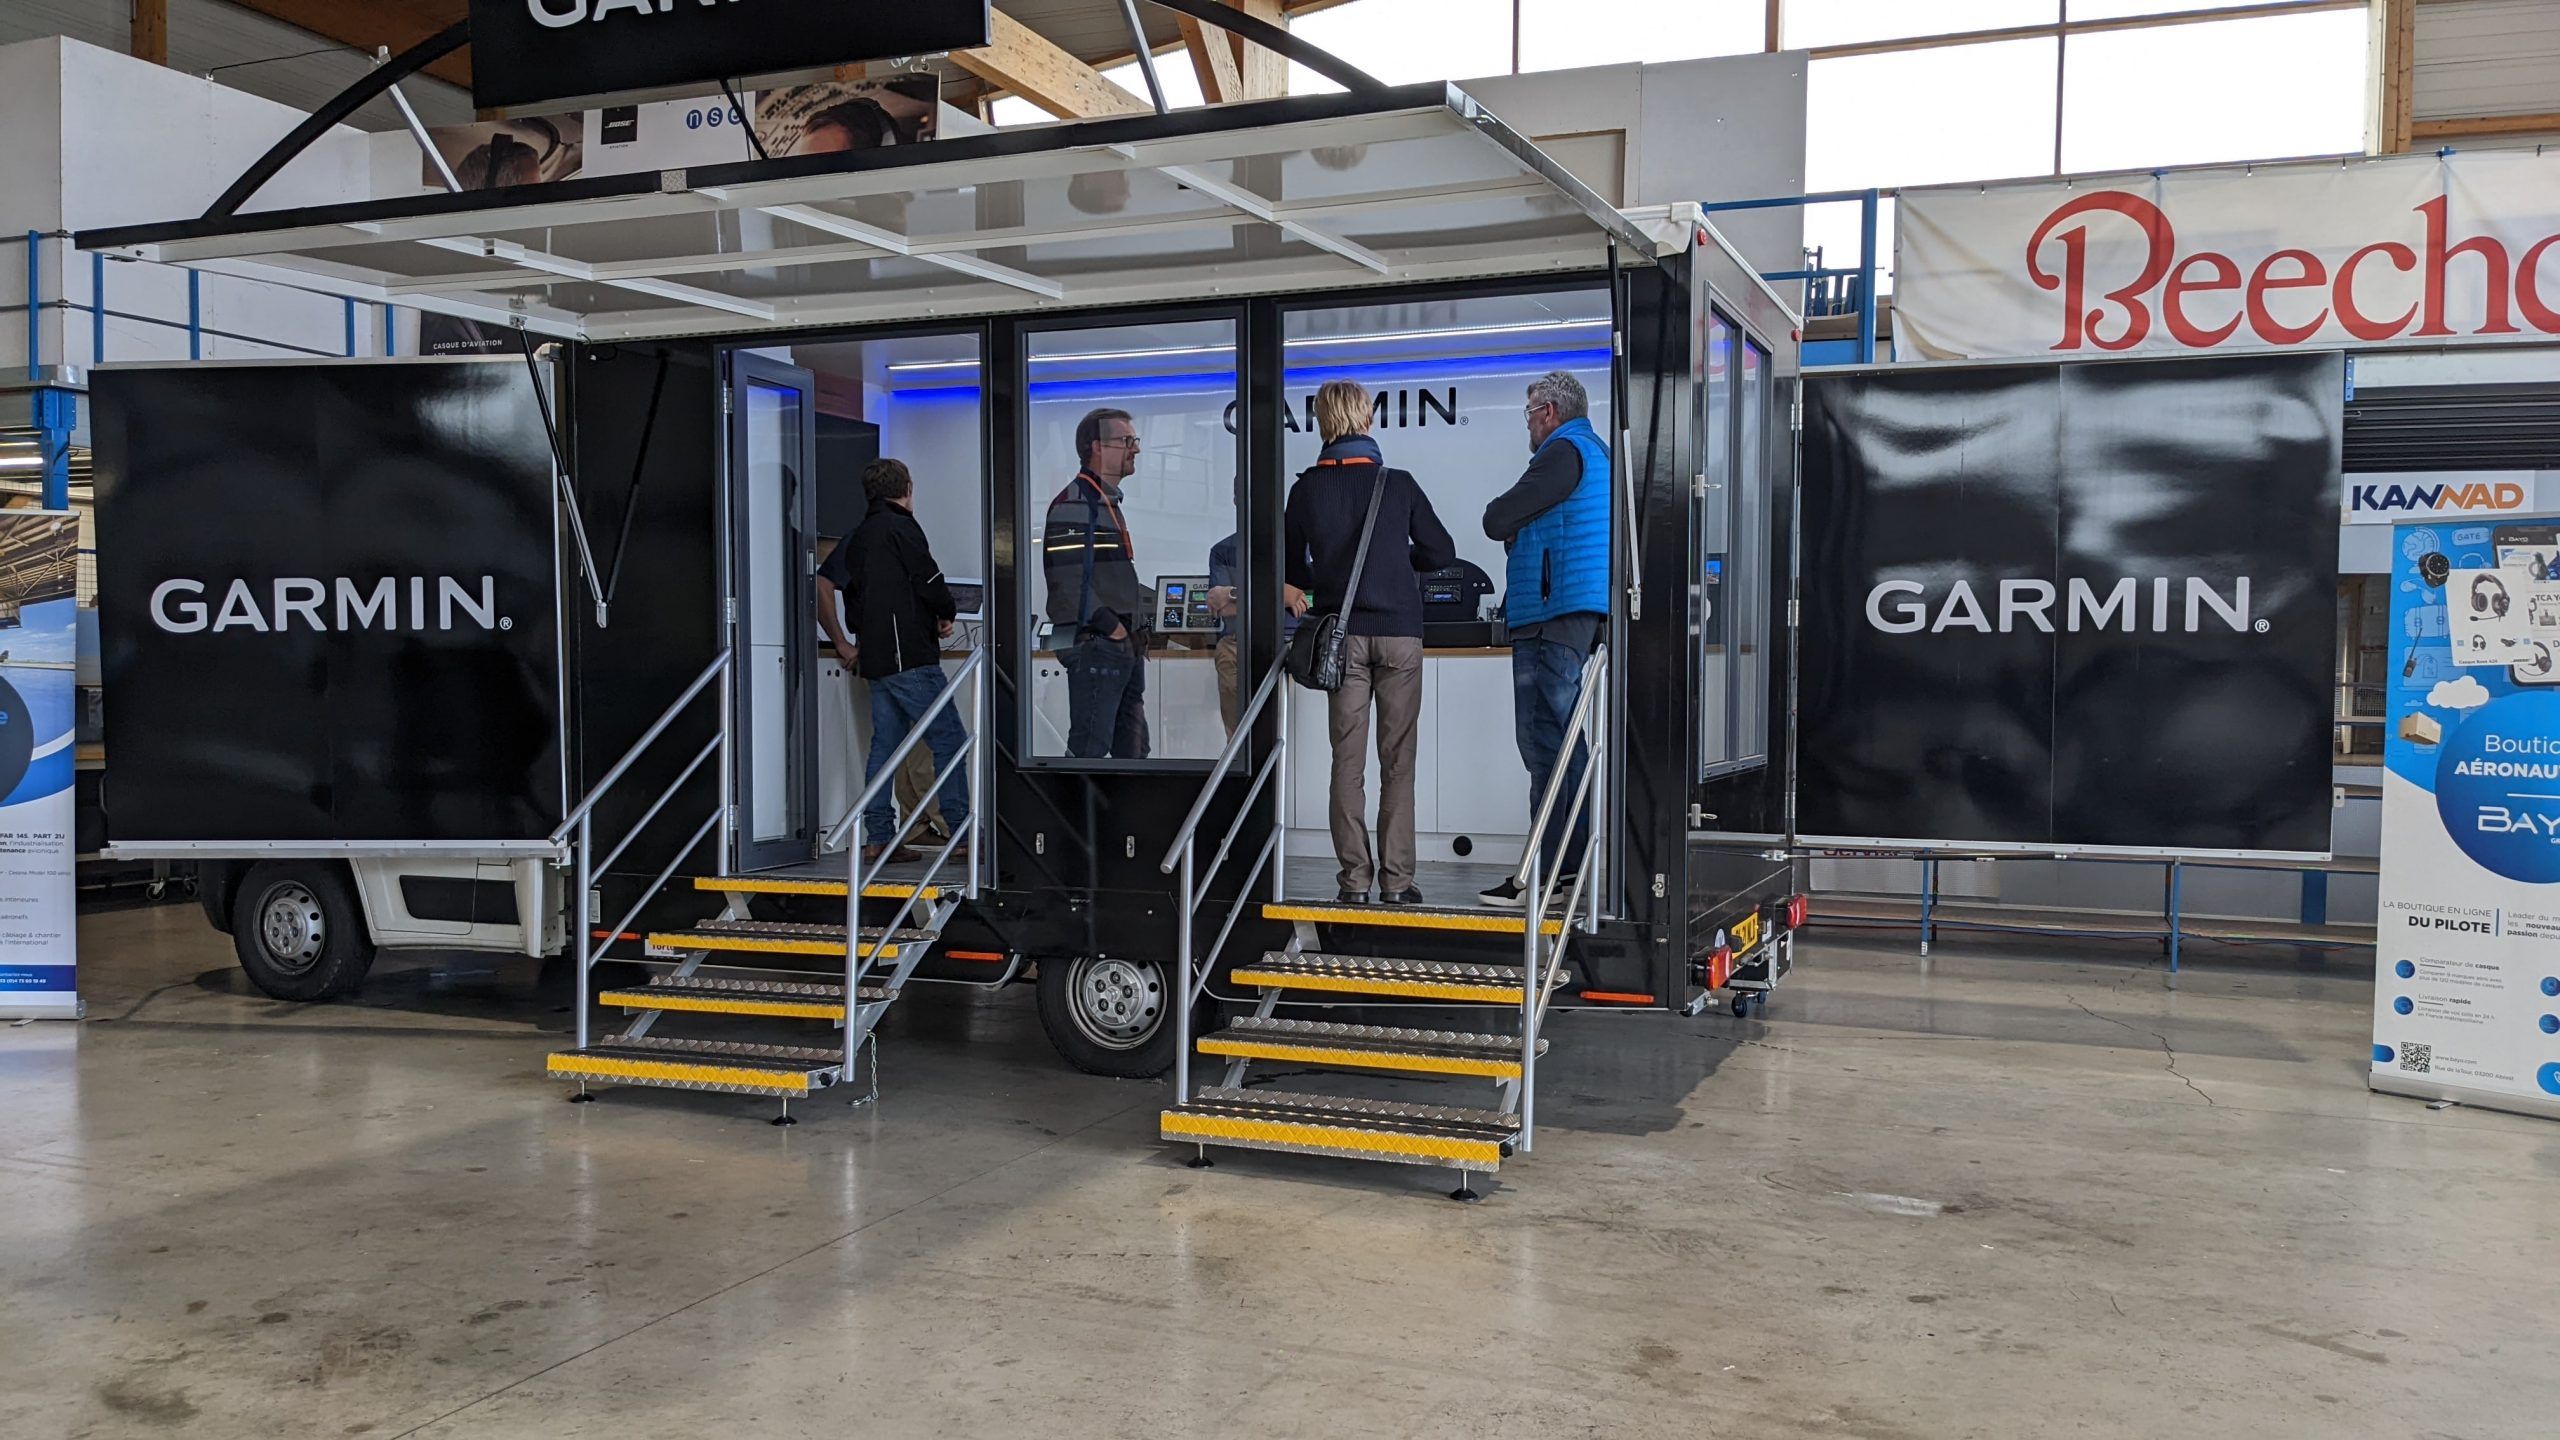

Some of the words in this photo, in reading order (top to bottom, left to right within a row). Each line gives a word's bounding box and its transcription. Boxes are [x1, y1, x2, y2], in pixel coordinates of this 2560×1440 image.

[433, 341, 459, 349] CASQUE
[462, 339, 502, 347] D'AVIATION
[2352, 483, 2525, 511] KANNAD
[2457, 533, 2480, 541] GATE
[2454, 757, 2560, 779] AÉRONAU
[2383, 901, 2395, 909] LA
[2398, 902, 2445, 914] BOUTIQUE
[2447, 906, 2461, 915] EN
[2463, 908, 2492, 918] LIGNE
[2508, 912, 2535, 920] Leader
[2408, 915, 2430, 928] DU
[2435, 918, 2491, 934] PILOTE
[2507, 929, 2538, 938] passion
[2475, 963, 2500, 971] casque
[2449, 997, 2471, 1005] rapide
